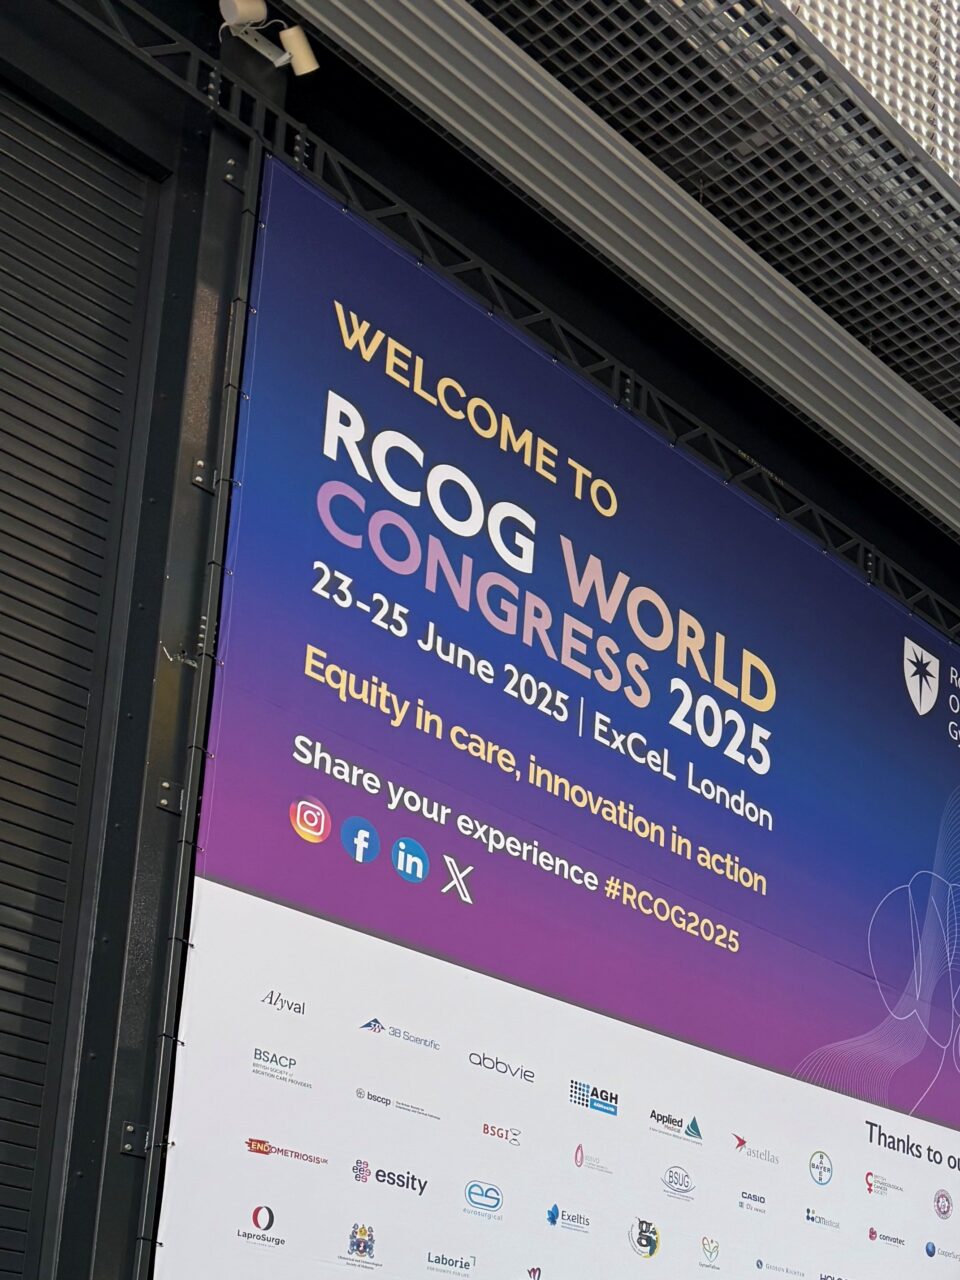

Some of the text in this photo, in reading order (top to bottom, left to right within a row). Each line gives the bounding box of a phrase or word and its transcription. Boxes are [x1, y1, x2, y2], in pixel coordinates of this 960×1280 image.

[334, 300, 618, 518] WELCOME TO
[323, 389, 777, 712] RCOG WORLD
[317, 480, 772, 776] CONGRESS 2025
[312, 561, 773, 831] 23-25 June 2025 ExCeL London
[304, 645, 766, 895] Equity in care, innovation in action
[293, 736, 740, 951] Share your experience #RCOG2025
[261, 990, 305, 1015] Alyval
[388, 1026, 441, 1051] 3B Scientific
[254, 1048, 296, 1069] BSACP
[469, 1052, 535, 1083] abbvie
[367, 1092, 391, 1106] bsccp
[591, 1087, 618, 1104] AGH
[650, 1110, 683, 1127] Applied
[483, 1123, 509, 1140] BSGI
[866, 1121, 922, 1158] Thanks
[927, 1146, 942, 1164] to
[251, 1142, 320, 1164] ENDOMETRIOSIS
[747, 1146, 780, 1165] astellas
[812, 1163, 831, 1173] BAYER
[376, 1168, 428, 1196] essity
[669, 1170, 689, 1187] BSUG
[742, 1192, 765, 1203] CASIO
[463, 1208, 503, 1221] eurosurgical
[561, 1210, 590, 1226] Exeltis
[237, 1229, 285, 1245] LaproSurge
[879, 1233, 905, 1245] convatec
[428, 1252, 470, 1270] Laborie
